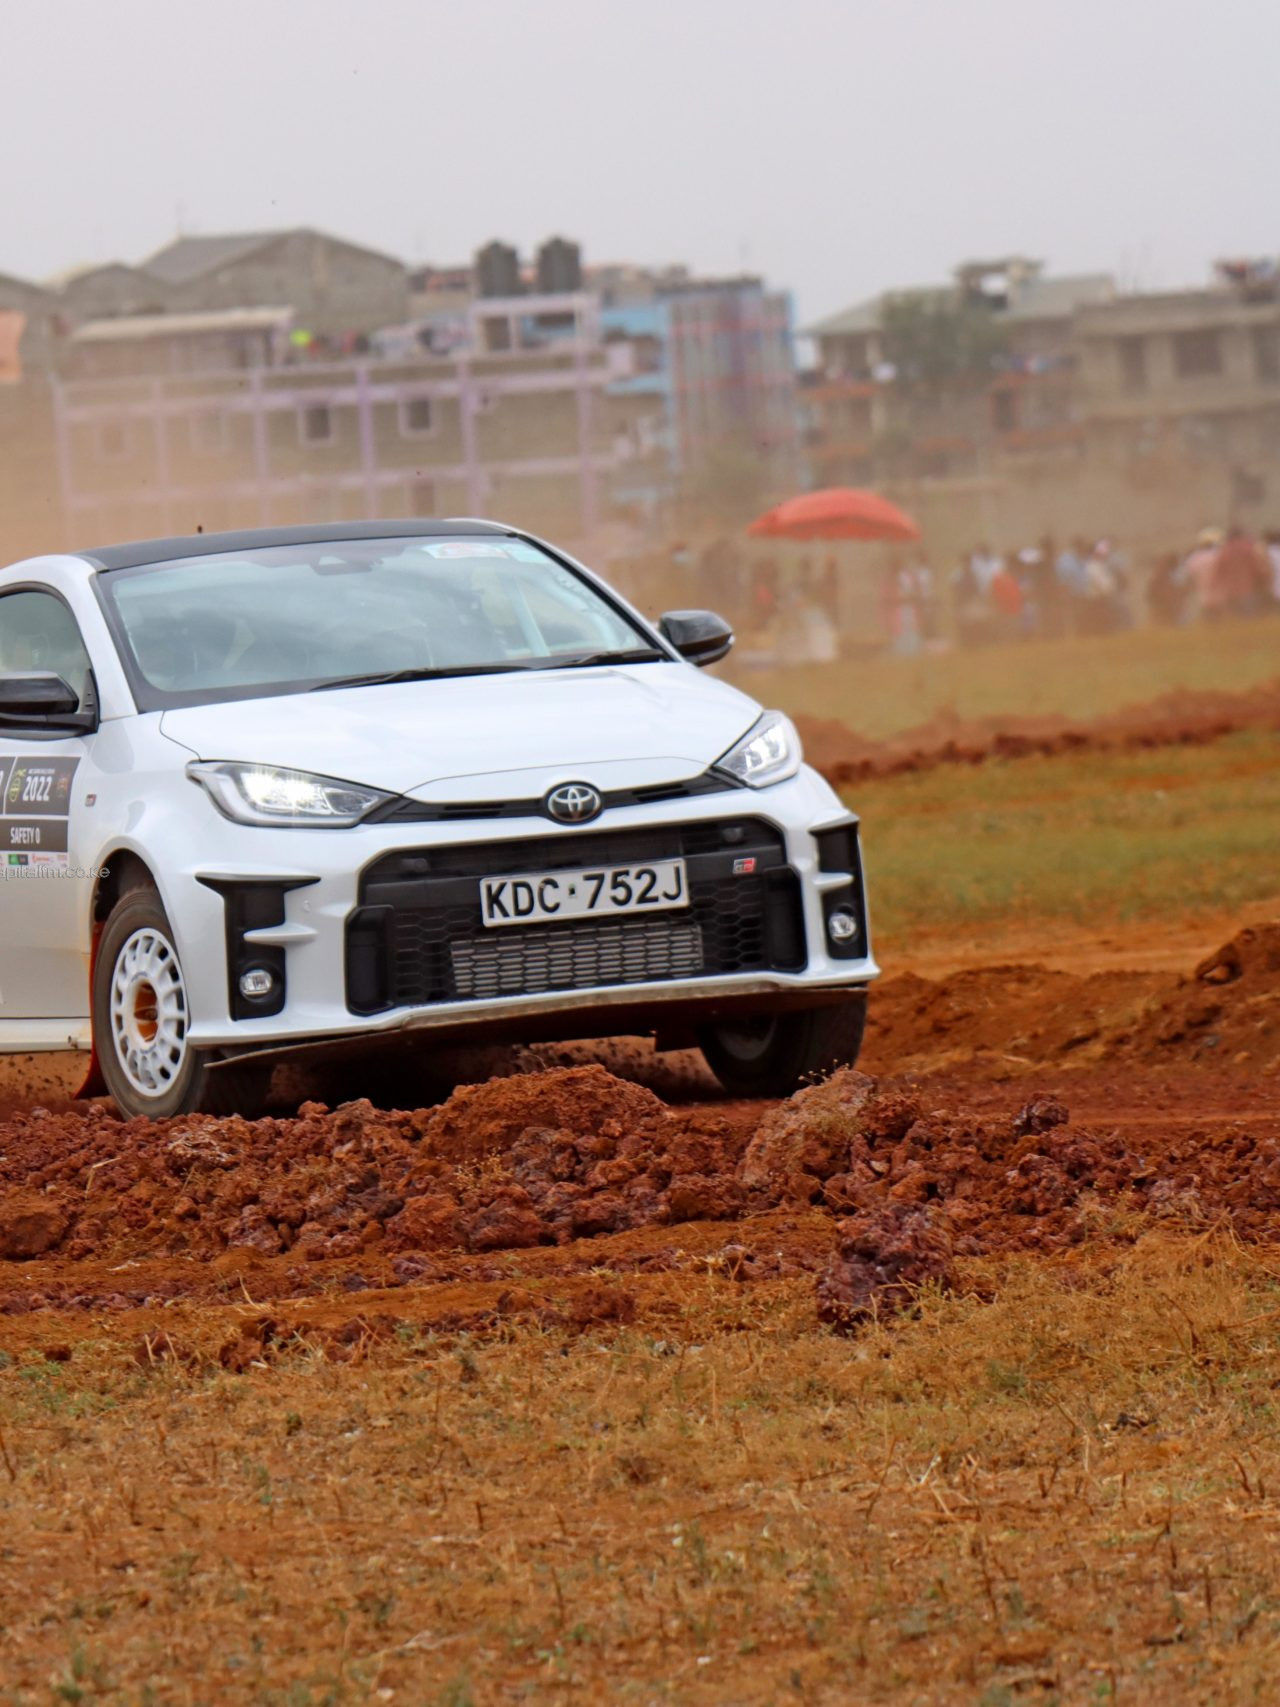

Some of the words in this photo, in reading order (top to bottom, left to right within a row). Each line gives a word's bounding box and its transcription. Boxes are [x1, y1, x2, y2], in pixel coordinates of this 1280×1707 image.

[22, 776, 53, 802] 2022
[10, 827, 35, 844] SAFETY
[485, 877, 561, 919] KDC
[582, 865, 682, 909] 752J
